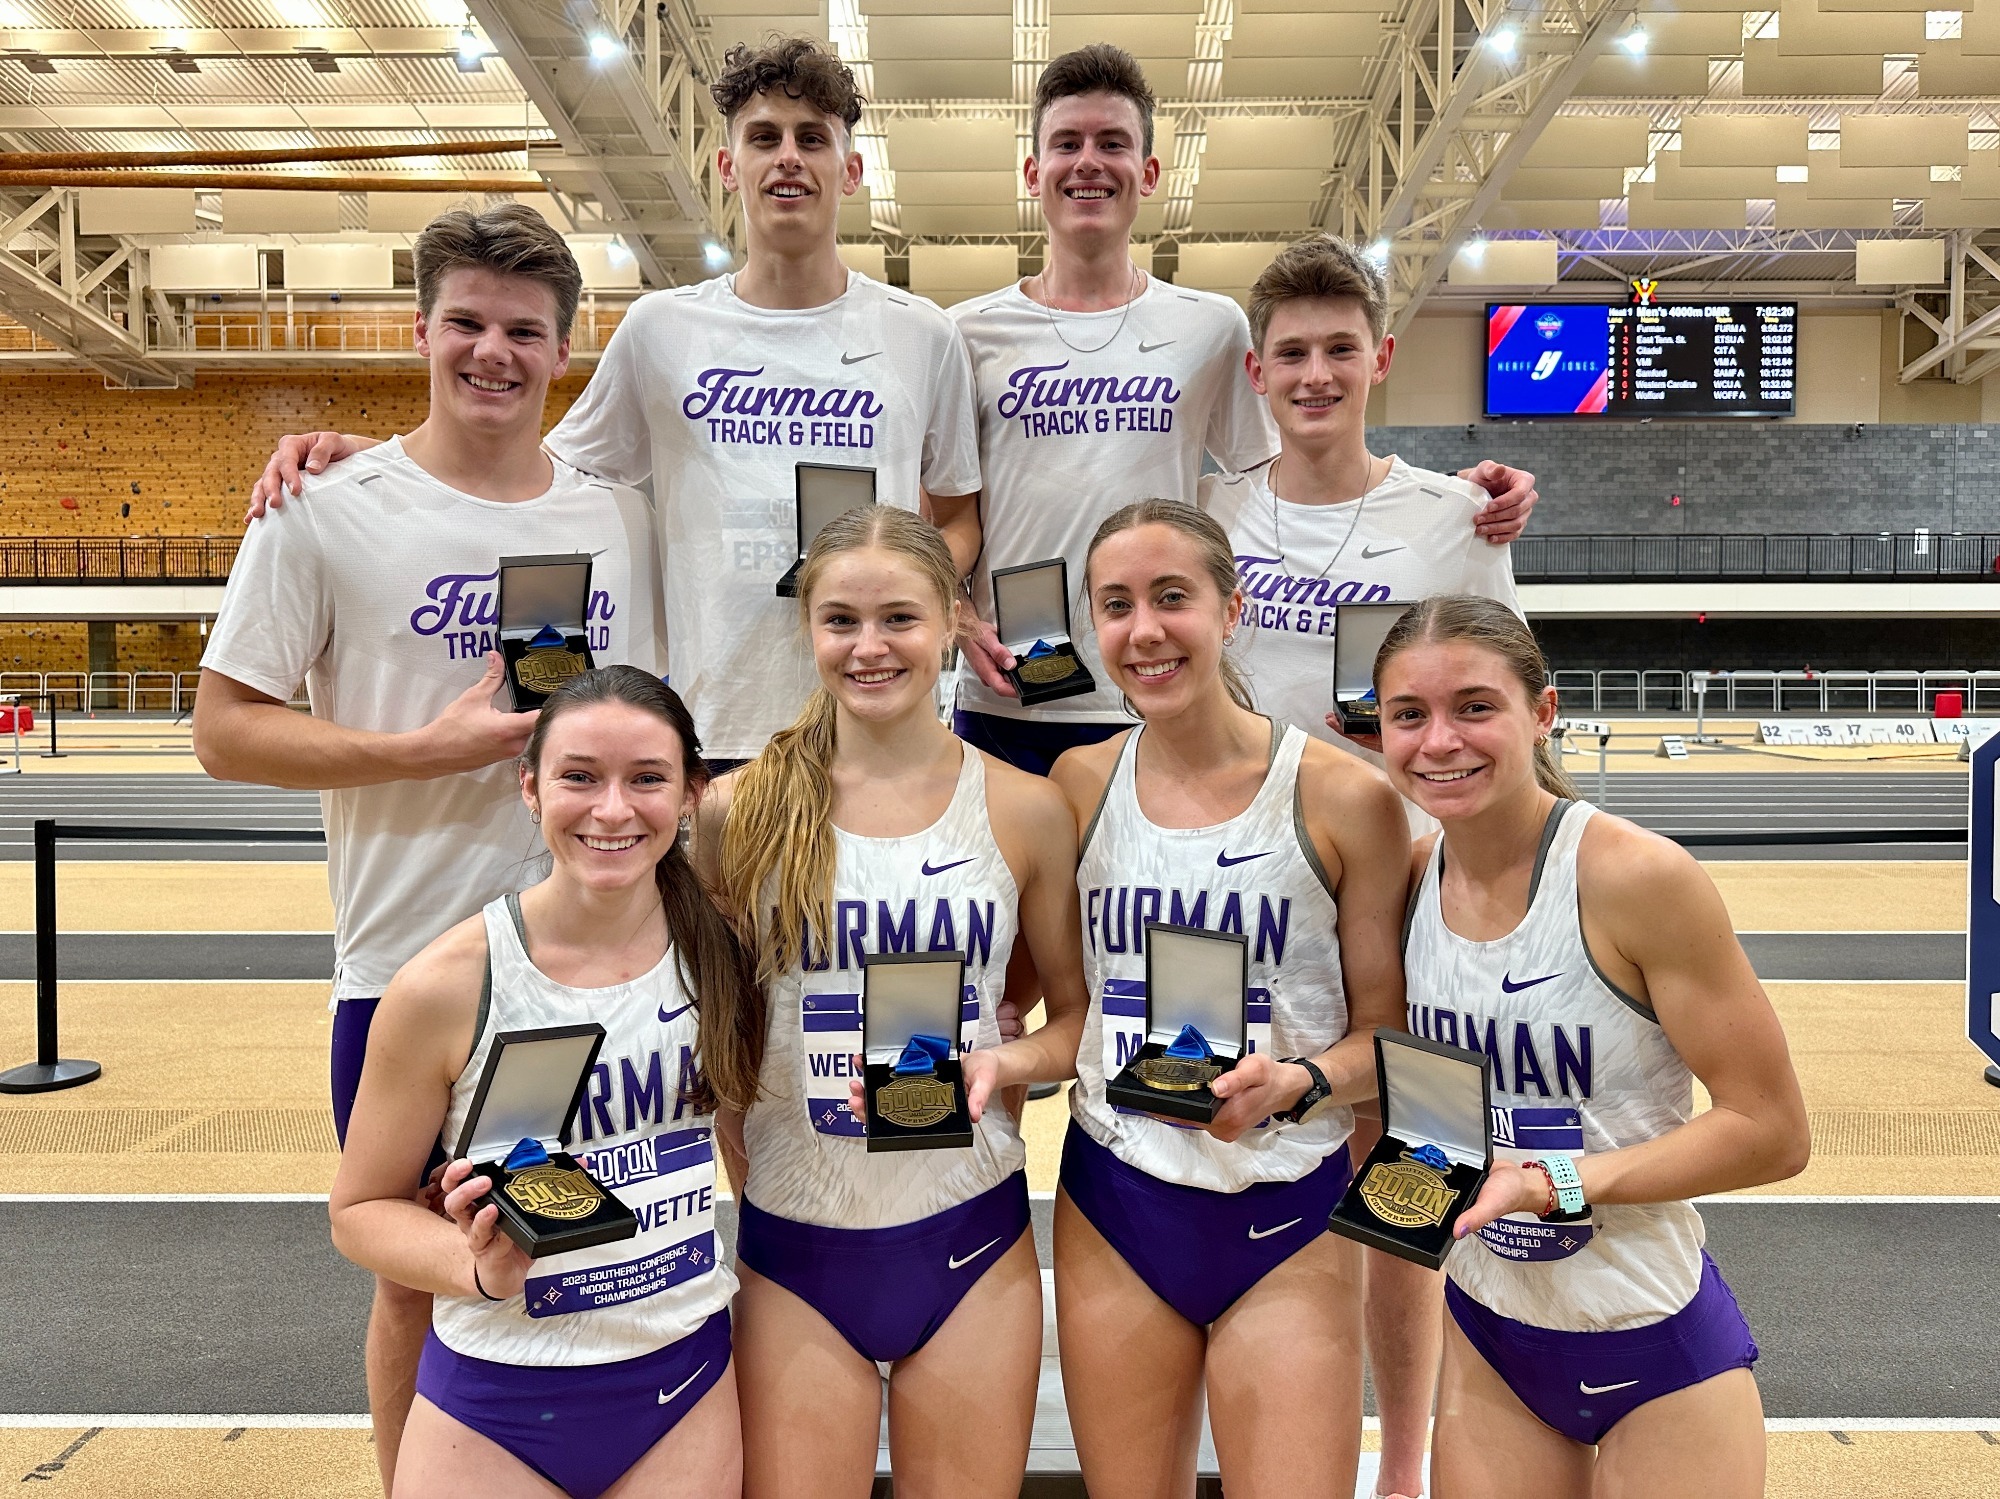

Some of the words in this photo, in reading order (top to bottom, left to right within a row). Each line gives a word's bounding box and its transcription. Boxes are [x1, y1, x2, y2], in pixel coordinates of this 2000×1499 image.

[1636, 306, 1667, 317] Men's
[1669, 306, 1703, 317] 4000m
[1704, 306, 1730, 317] DMR
[1755, 306, 1795, 317] 7:02:20
[1608, 324, 1616, 333] 7
[1623, 325, 1629, 333] 1
[1738, 324, 1747, 333] A
[1608, 335, 1615, 344] 4
[1622, 336, 1629, 344] 2
[1736, 335, 1745, 344] A
[1608, 346, 1615, 355] 3
[1622, 347, 1629, 355] 3
[1713, 346, 1728, 355] CIT
[1728, 346, 1736, 355] A
[1729, 358, 1737, 366] A
[1498, 362, 1531, 371] HERFF
[1736, 369, 1745, 377] A
[683, 366, 883, 420] Furman
[998, 359, 1181, 419] Furman
[1607, 380, 1615, 389] 2
[1621, 381, 1628, 389] 6
[1733, 380, 1742, 389] A
[1608, 391, 1614, 399] 1
[1713, 391, 1738, 399] WOFF
[1738, 391, 1747, 399] A
[707, 418, 782, 445] TRACK
[789, 425, 804, 445] &
[811, 422, 873, 448] FIELD
[1020, 410, 1089, 438] TRACK
[1095, 409, 1109, 432] &
[1116, 407, 1172, 433] FIELD
[1240, 603, 1289, 631] RACK
[1296, 610, 1312, 633] &
[517, 655, 585, 682] SOCON
[1762, 725, 1782, 736] 32
[1813, 725, 1832, 736] 35
[1896, 724, 1915, 736] 40
[1952, 724, 1970, 735] 43
[878, 1083, 954, 1116] SOCON
[582, 1136, 658, 1186] SOCON
[1394, 1165, 1439, 1186] SOUTHERN
[508, 1170, 600, 1212] SOCON
[1362, 1163, 1455, 1220] SOCON
[631, 1185, 712, 1233] VETTE
[1370, 1197, 1425, 1223] CONFERENCE
[1483, 1228, 1507, 1244] TRACK
[1508, 1237, 1515, 1246] &
[1516, 1237, 1541, 1248] FIELD
[1499, 1222, 1556, 1238] CONFERENCE
[562, 1275, 587, 1287] 2023
[589, 1264, 638, 1282] SOUTHERN
[640, 1245, 687, 1270] CONFERENCE
[580, 1283, 614, 1296] INDOOR
[616, 1272, 647, 1288] TRACK
[650, 1272, 655, 1280] &
[656, 1262, 676, 1278] FIELD
[594, 1277, 667, 1305] CHAMPIONSHIPS
